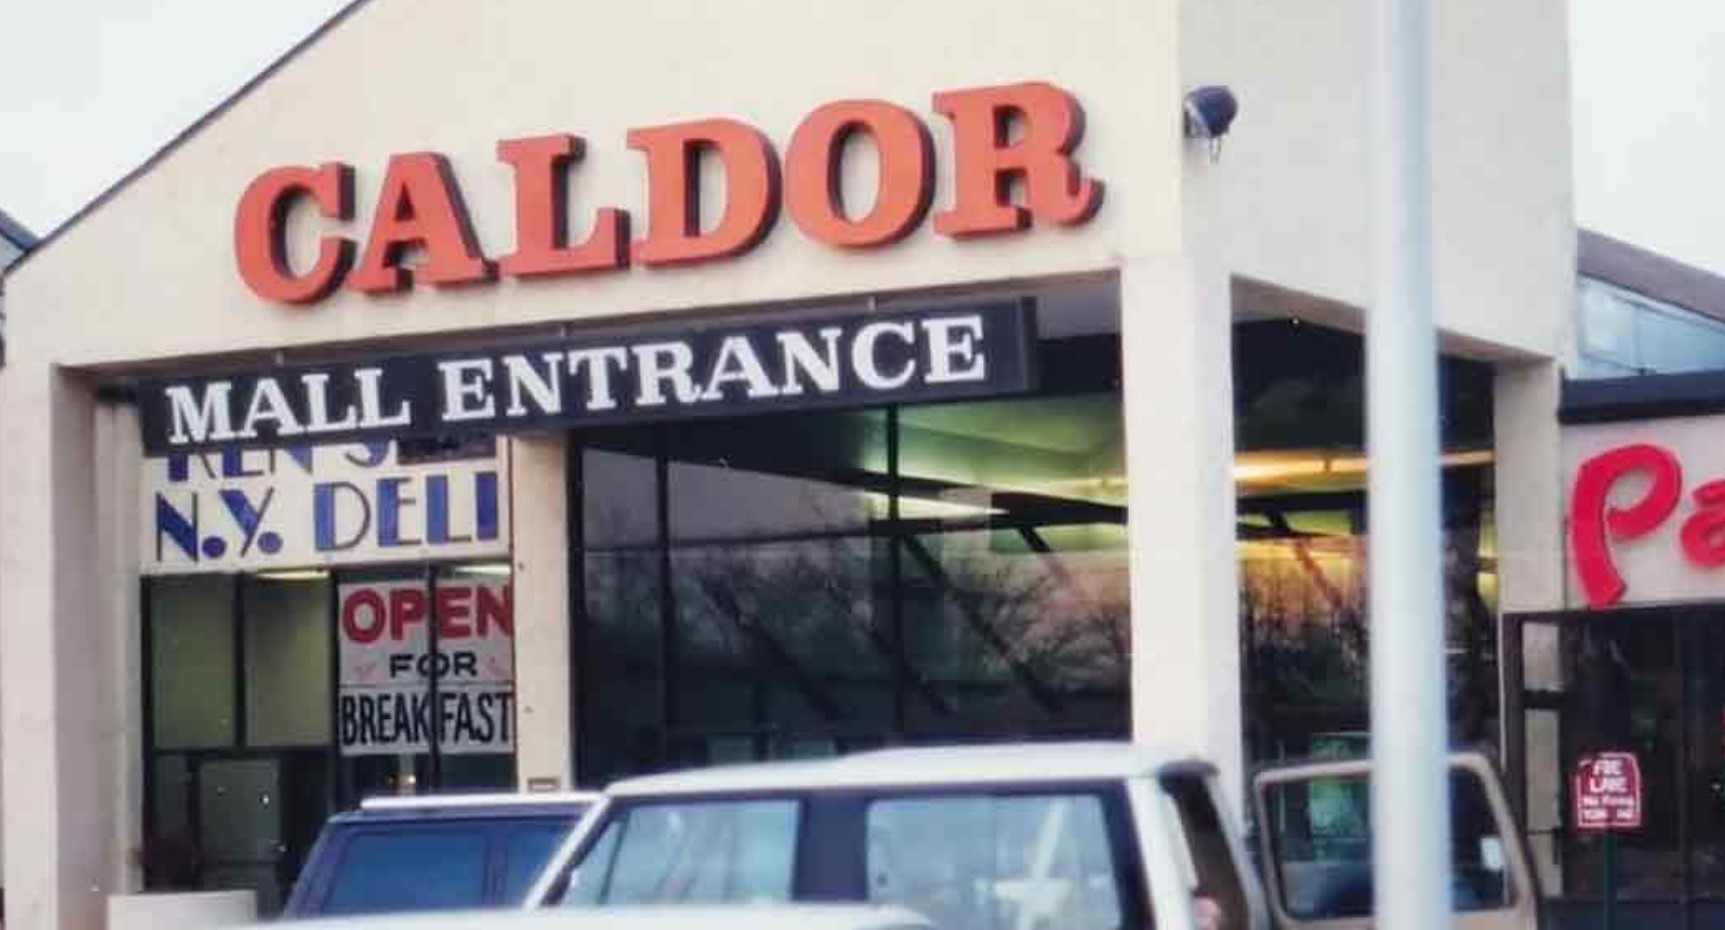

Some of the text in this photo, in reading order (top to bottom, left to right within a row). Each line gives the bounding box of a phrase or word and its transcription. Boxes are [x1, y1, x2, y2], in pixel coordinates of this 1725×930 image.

[233, 81, 1106, 305] CALDOR
[164, 315, 985, 444] MALL ENTRANCE
[155, 470, 498, 562] N.Y. DELI
[342, 584, 512, 644] OPEN
[389, 651, 478, 679] FOR
[340, 690, 511, 747] BREAKFAST
